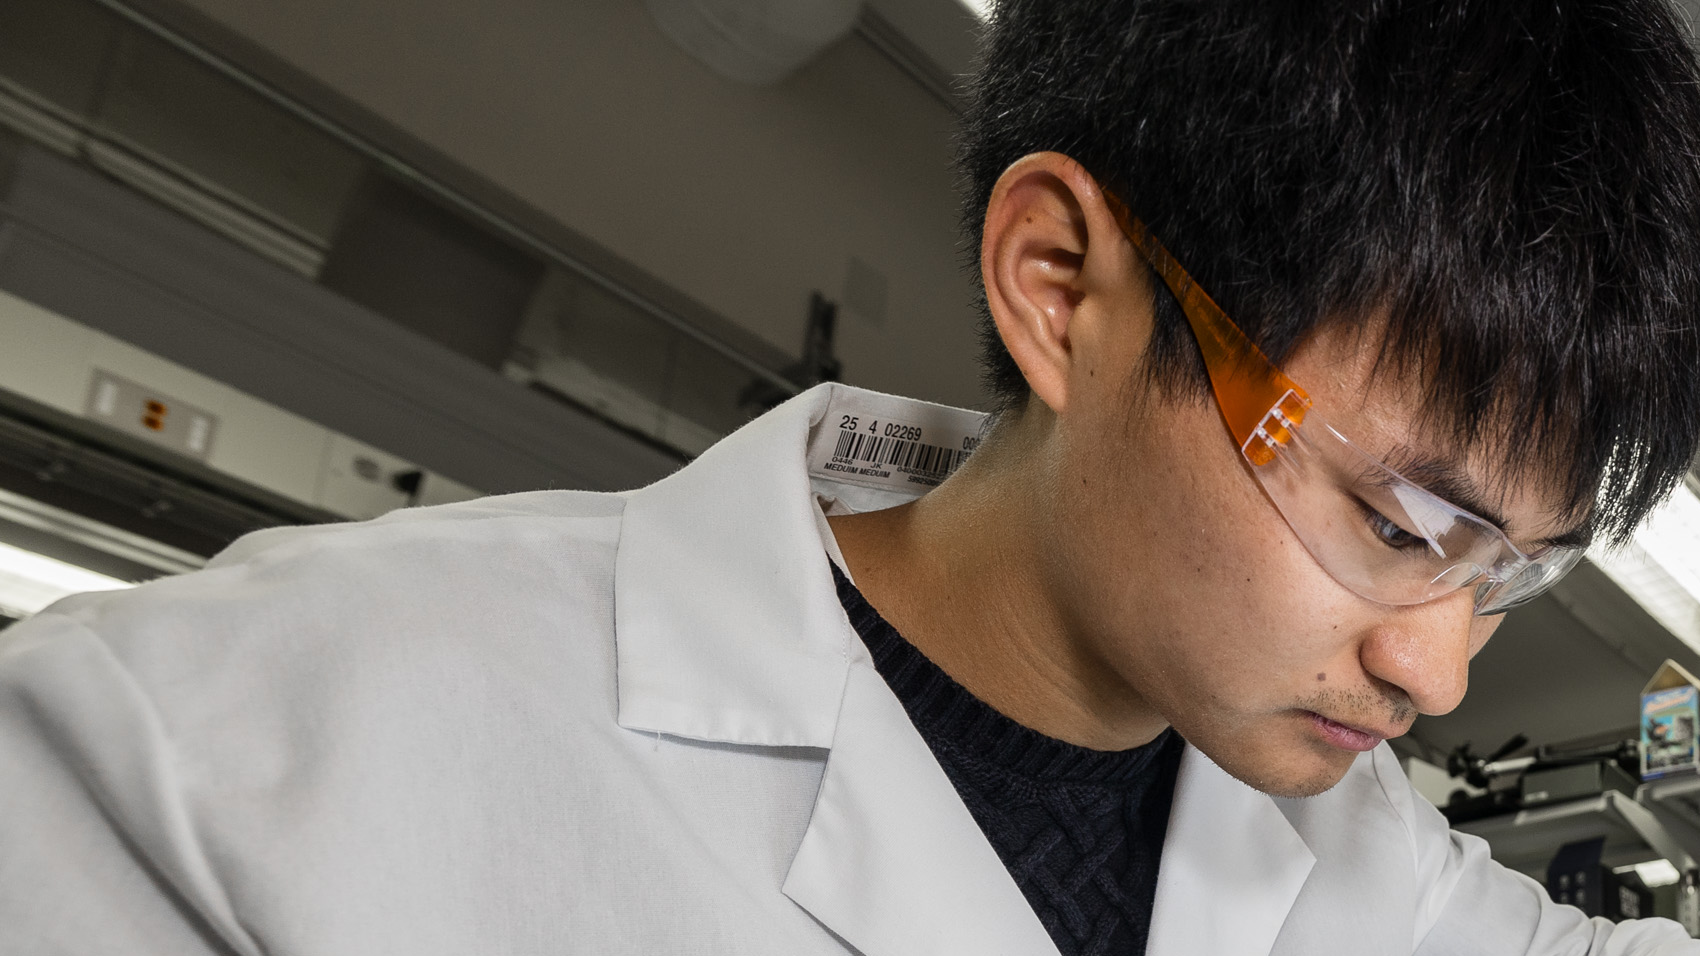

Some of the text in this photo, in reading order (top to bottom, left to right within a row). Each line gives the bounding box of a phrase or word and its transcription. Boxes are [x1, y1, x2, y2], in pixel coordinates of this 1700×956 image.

[839, 415, 859, 431] 25
[868, 420, 878, 434] 4
[884, 422, 922, 441] 02269
[824, 462, 859, 475] MEDUIM
[859, 467, 891, 479] MEDUIM
[870, 462, 882, 470] JK
